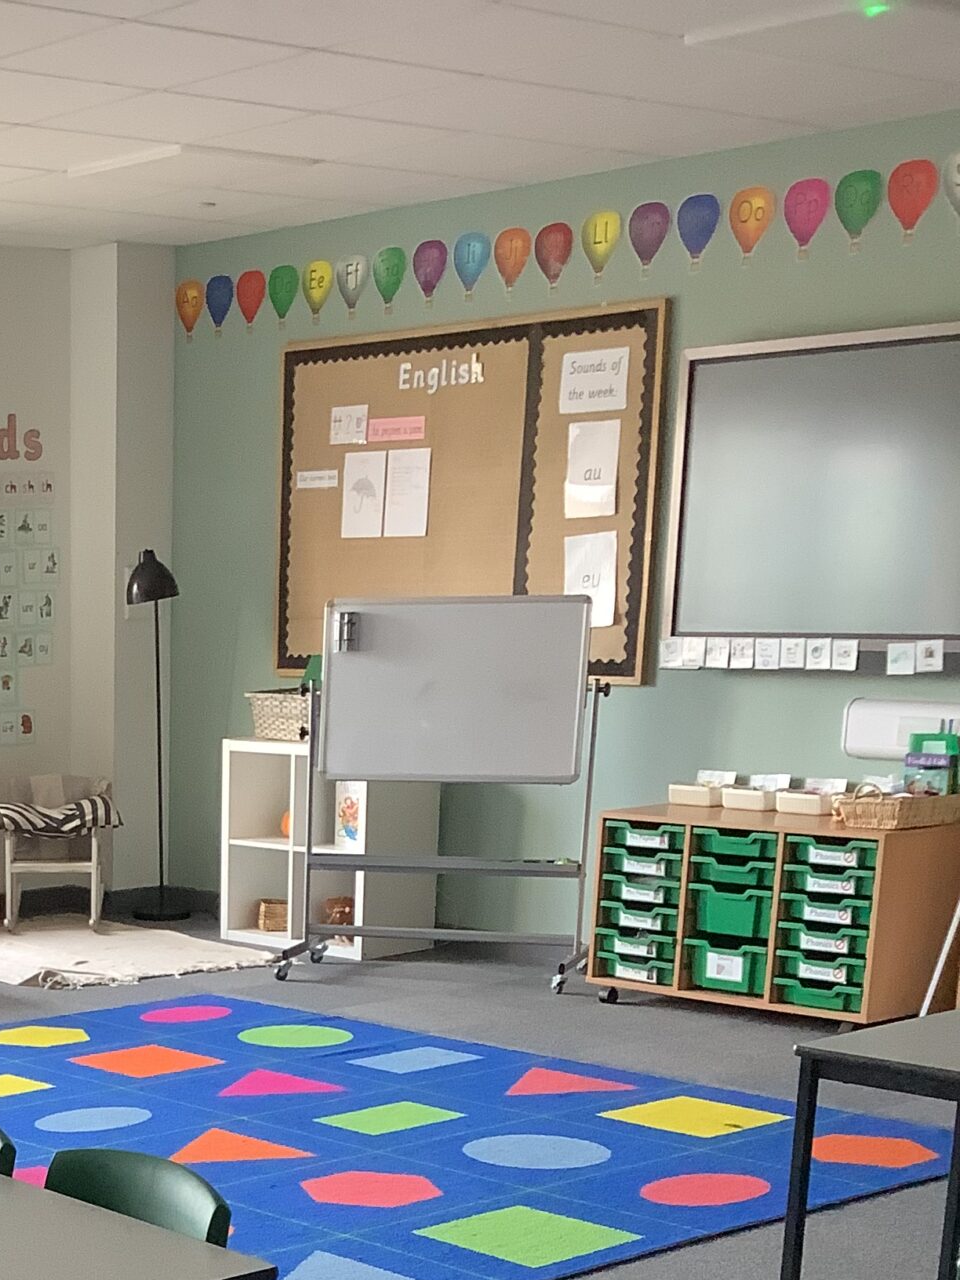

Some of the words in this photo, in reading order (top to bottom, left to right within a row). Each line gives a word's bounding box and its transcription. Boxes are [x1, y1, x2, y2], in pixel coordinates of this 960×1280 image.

[308, 269, 325, 290] Ee
[345, 261, 360, 291] Ff
[593, 220, 610, 245] Ll
[737, 200, 765, 223] Oo
[398, 352, 485, 395] English
[569, 359, 607, 375] Sounds
[611, 356, 624, 376] of
[568, 387, 584, 401] the
[583, 466, 602, 481] au
